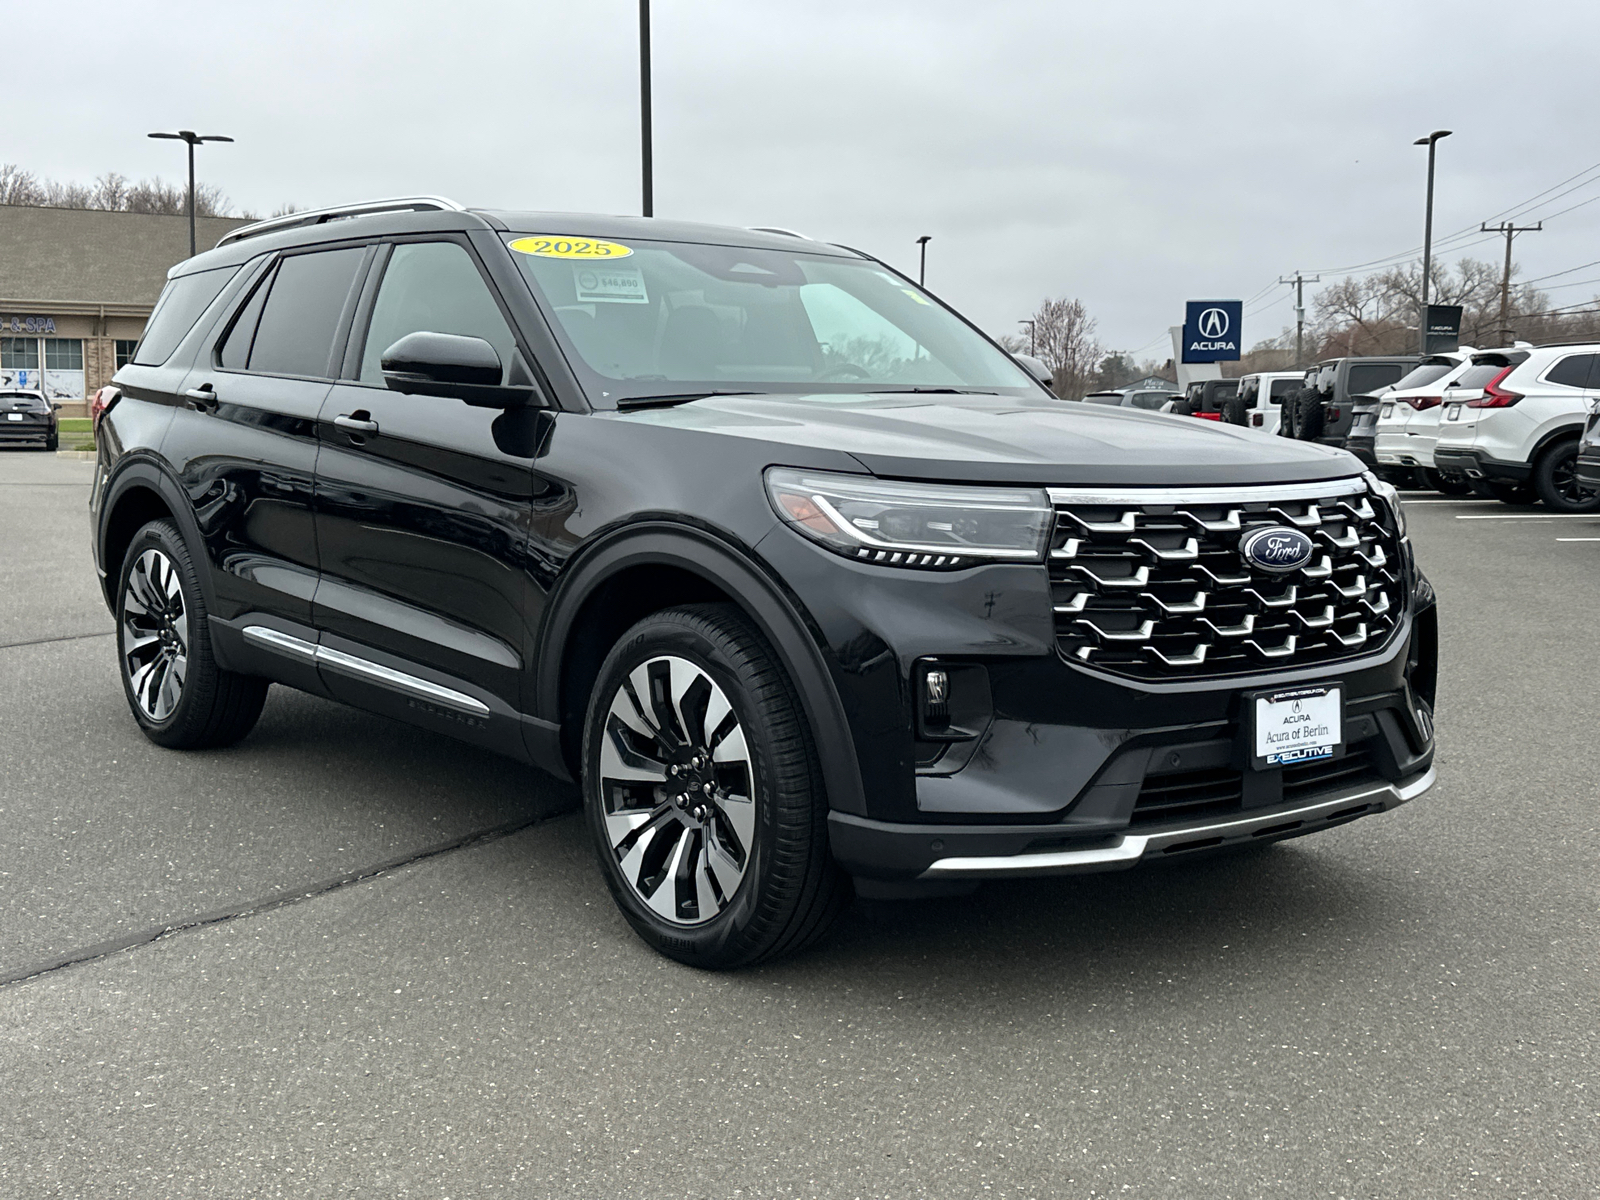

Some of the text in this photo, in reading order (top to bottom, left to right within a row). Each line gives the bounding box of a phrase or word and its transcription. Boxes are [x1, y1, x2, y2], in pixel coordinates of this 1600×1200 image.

[534, 240, 611, 256] 2025
[601, 276, 638, 289] $46,890
[10, 317, 22, 333] &
[25, 317, 56, 333] SPA
[1190, 341, 1236, 351] ACURA
[1265, 537, 1301, 560] Ford
[1283, 714, 1311, 725] ACURA
[1266, 724, 1329, 744] Acura of Berlin
[1267, 745, 1333, 764] EXECUTIVE
